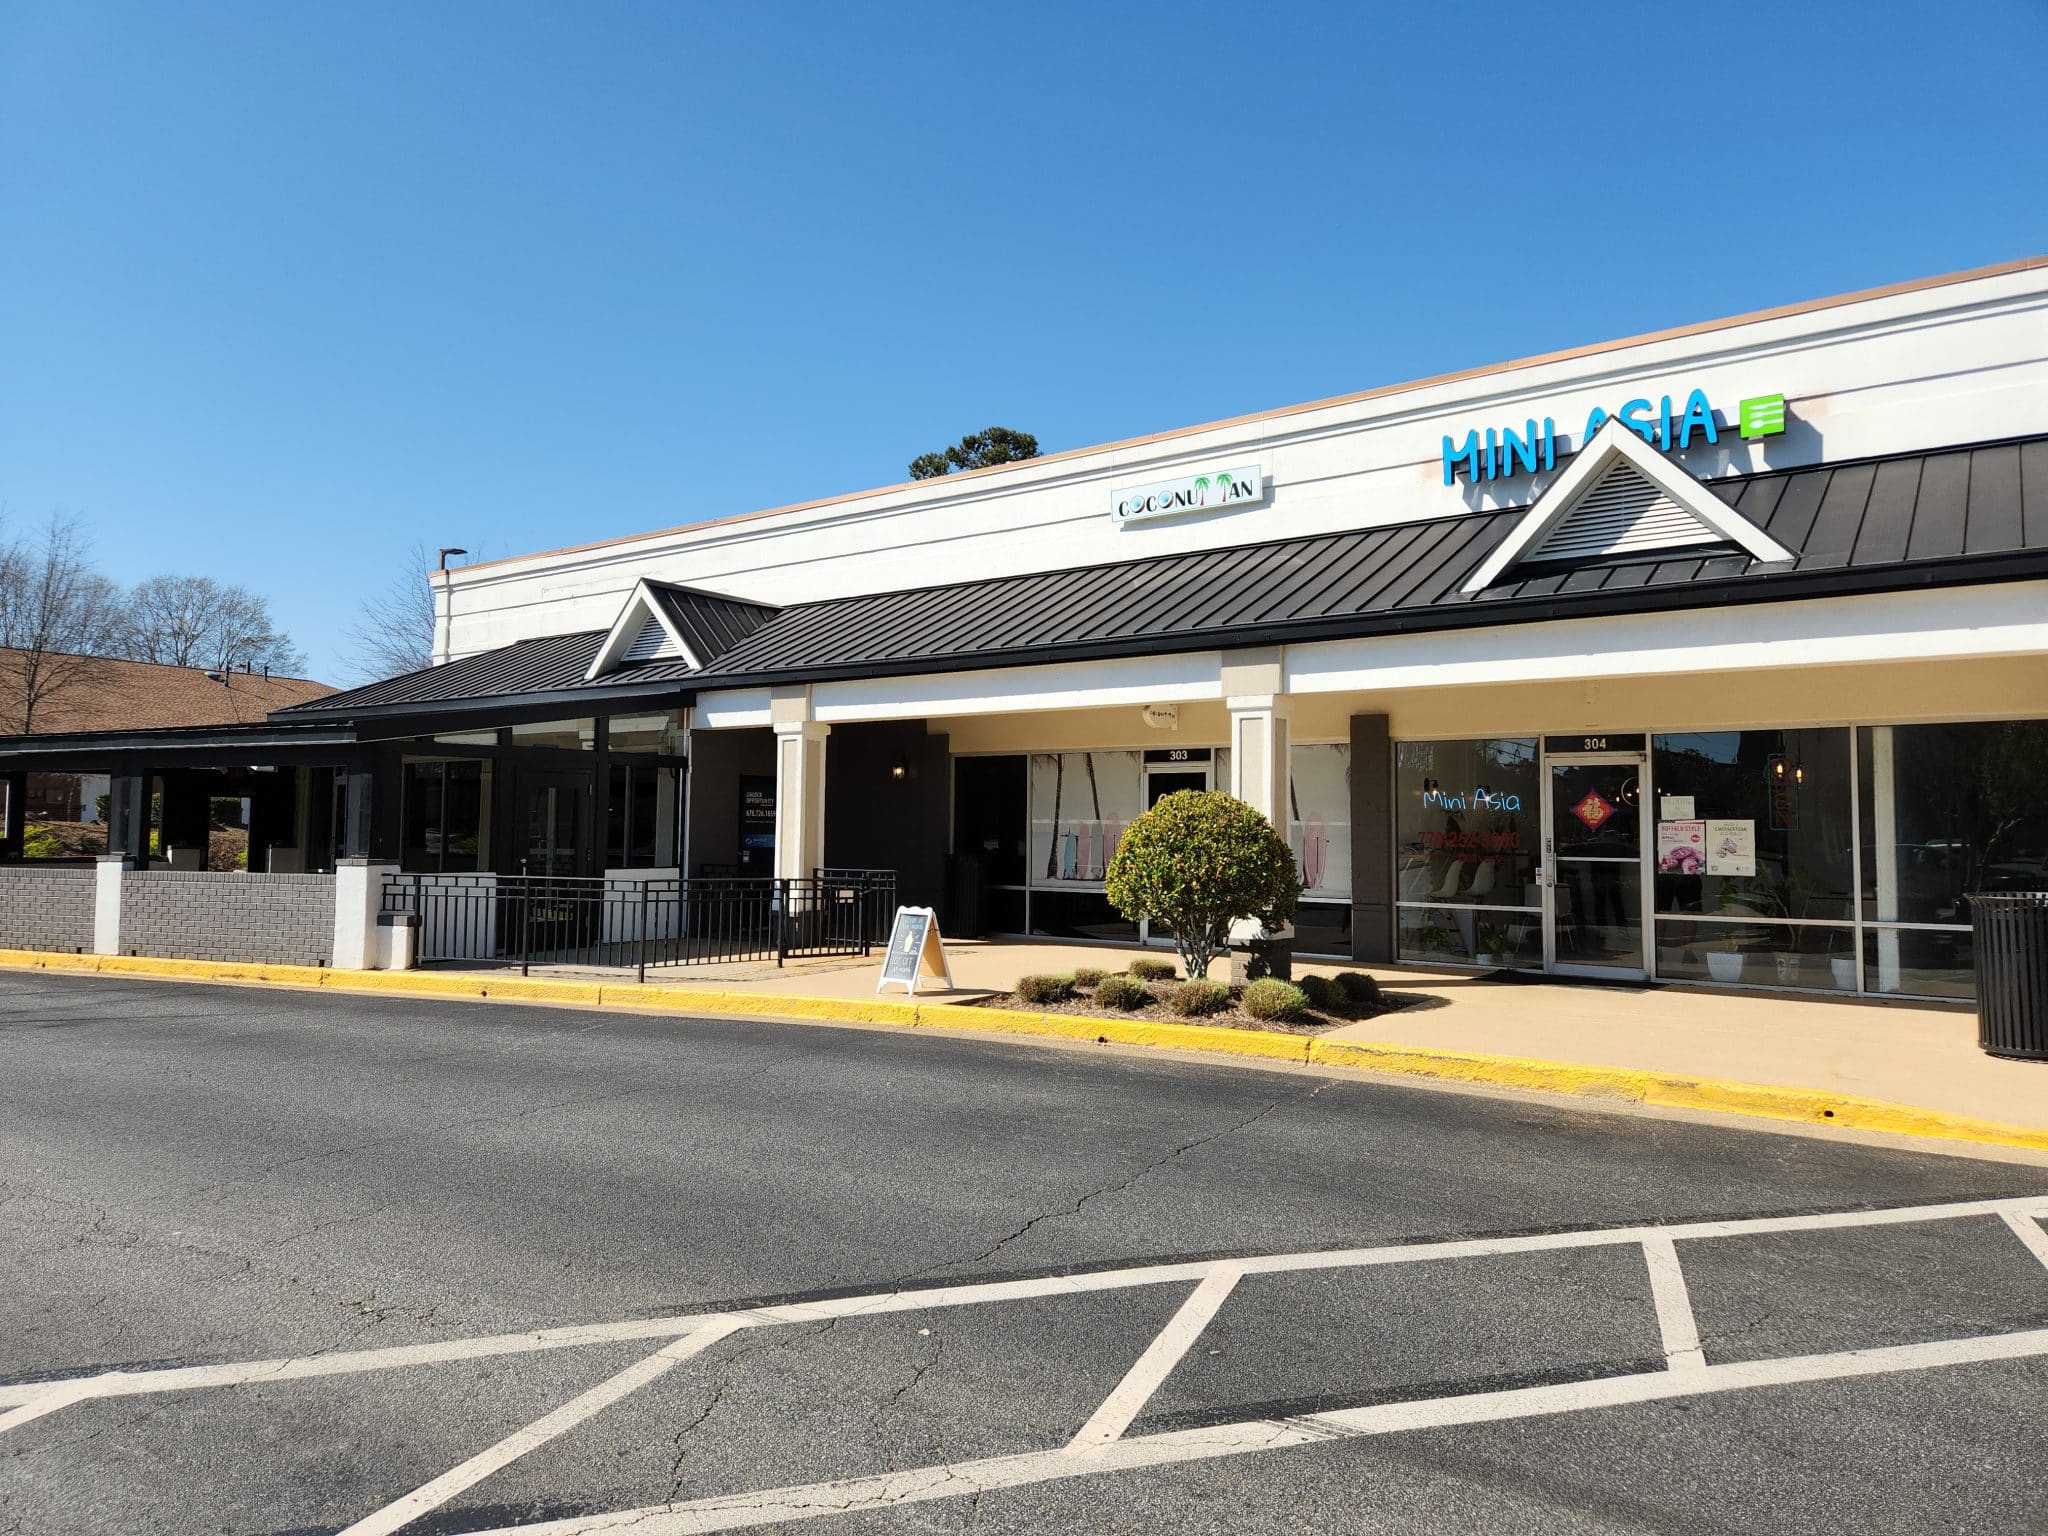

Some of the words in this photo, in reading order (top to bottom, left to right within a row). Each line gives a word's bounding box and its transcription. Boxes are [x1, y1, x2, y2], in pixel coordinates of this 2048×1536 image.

[1443, 417, 1555, 486] MINI
[1584, 389, 1717, 452] ASIA
[1584, 738, 1607, 750] 304
[1169, 750, 1189, 761] 303
[1423, 791, 1467, 810] Mini
[1473, 786, 1521, 811] Asia
